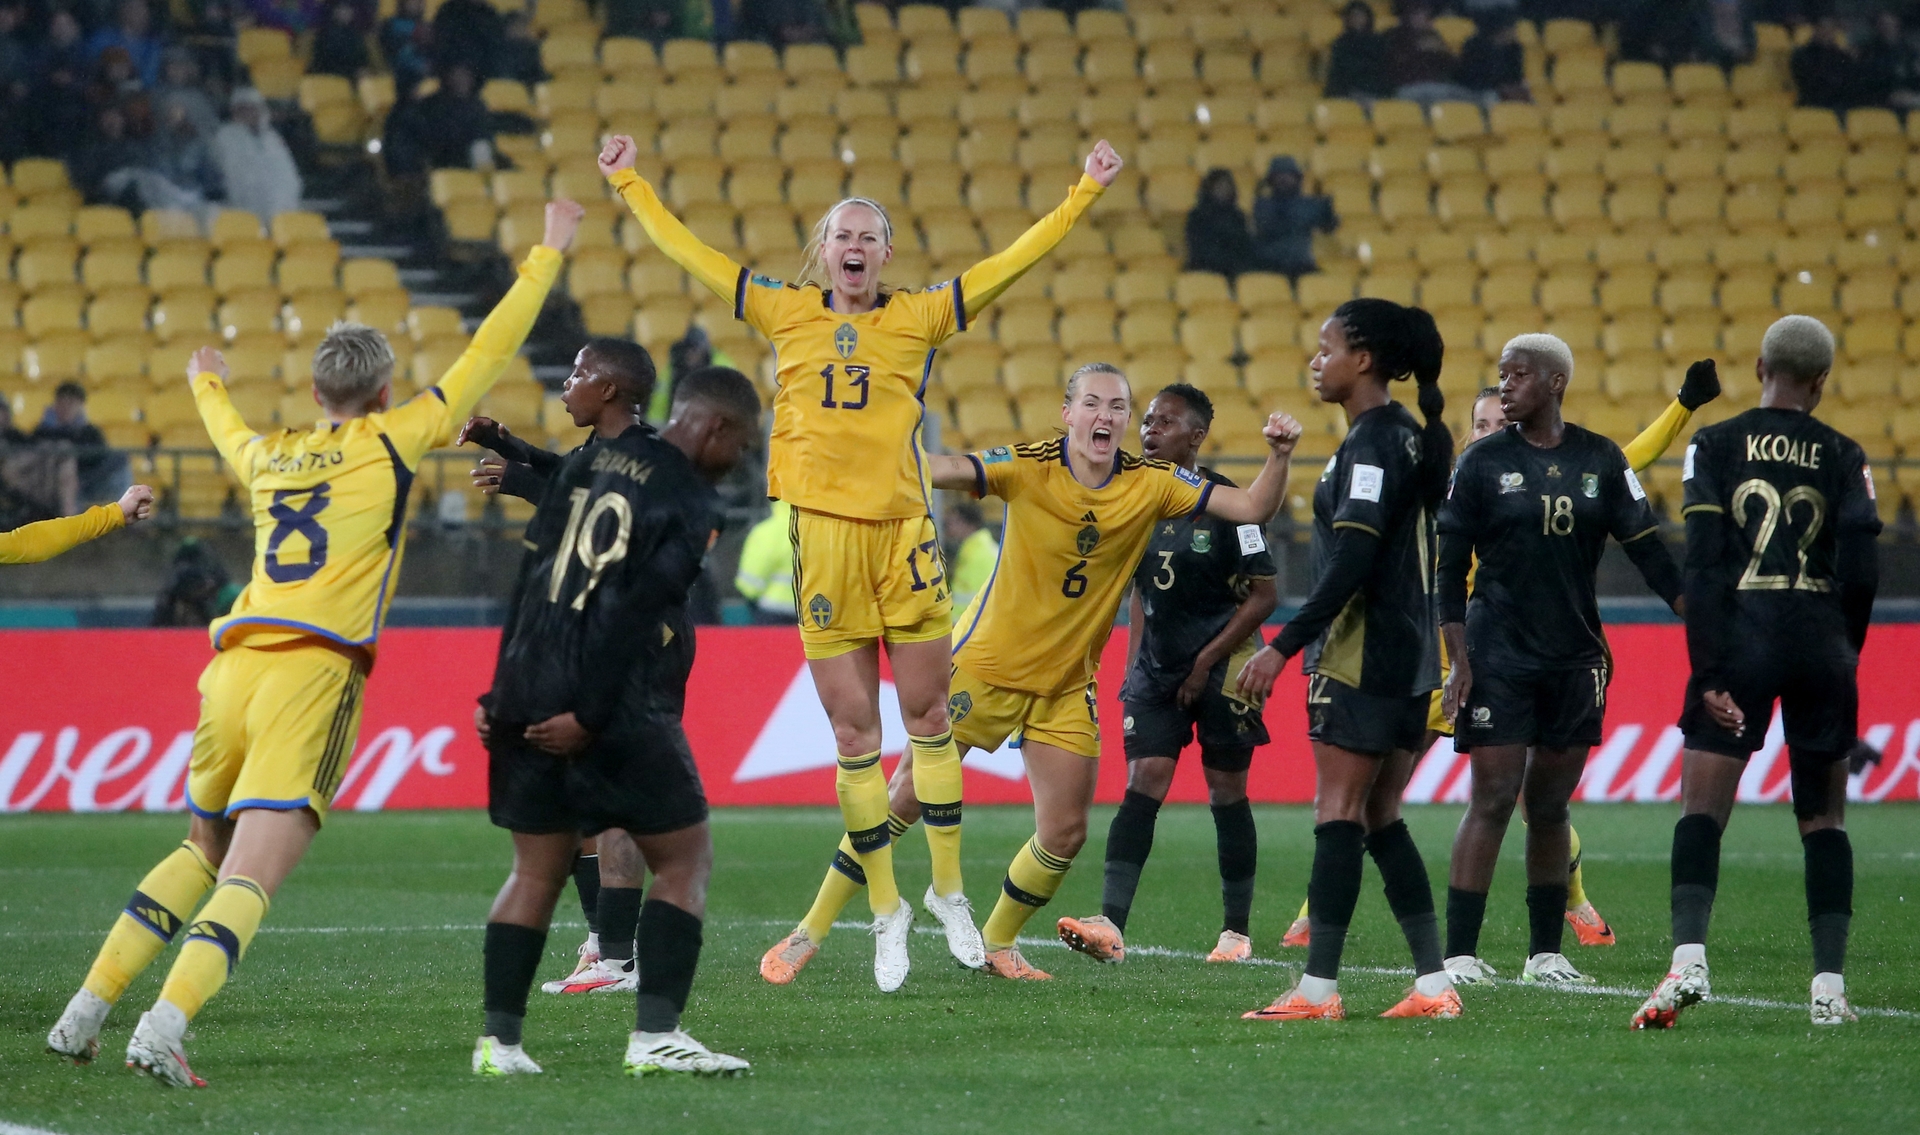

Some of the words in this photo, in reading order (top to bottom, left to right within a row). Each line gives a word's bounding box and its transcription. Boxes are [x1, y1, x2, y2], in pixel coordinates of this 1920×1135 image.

[819, 363, 871, 410] 13
[264, 482, 331, 583] 8
[1541, 494, 1575, 536] 18
[1731, 478, 1831, 592] 22
[549, 486, 633, 611] 19
[906, 539, 944, 592] 13
[1153, 550, 1175, 591] 3
[1061, 560, 1088, 599] 6
